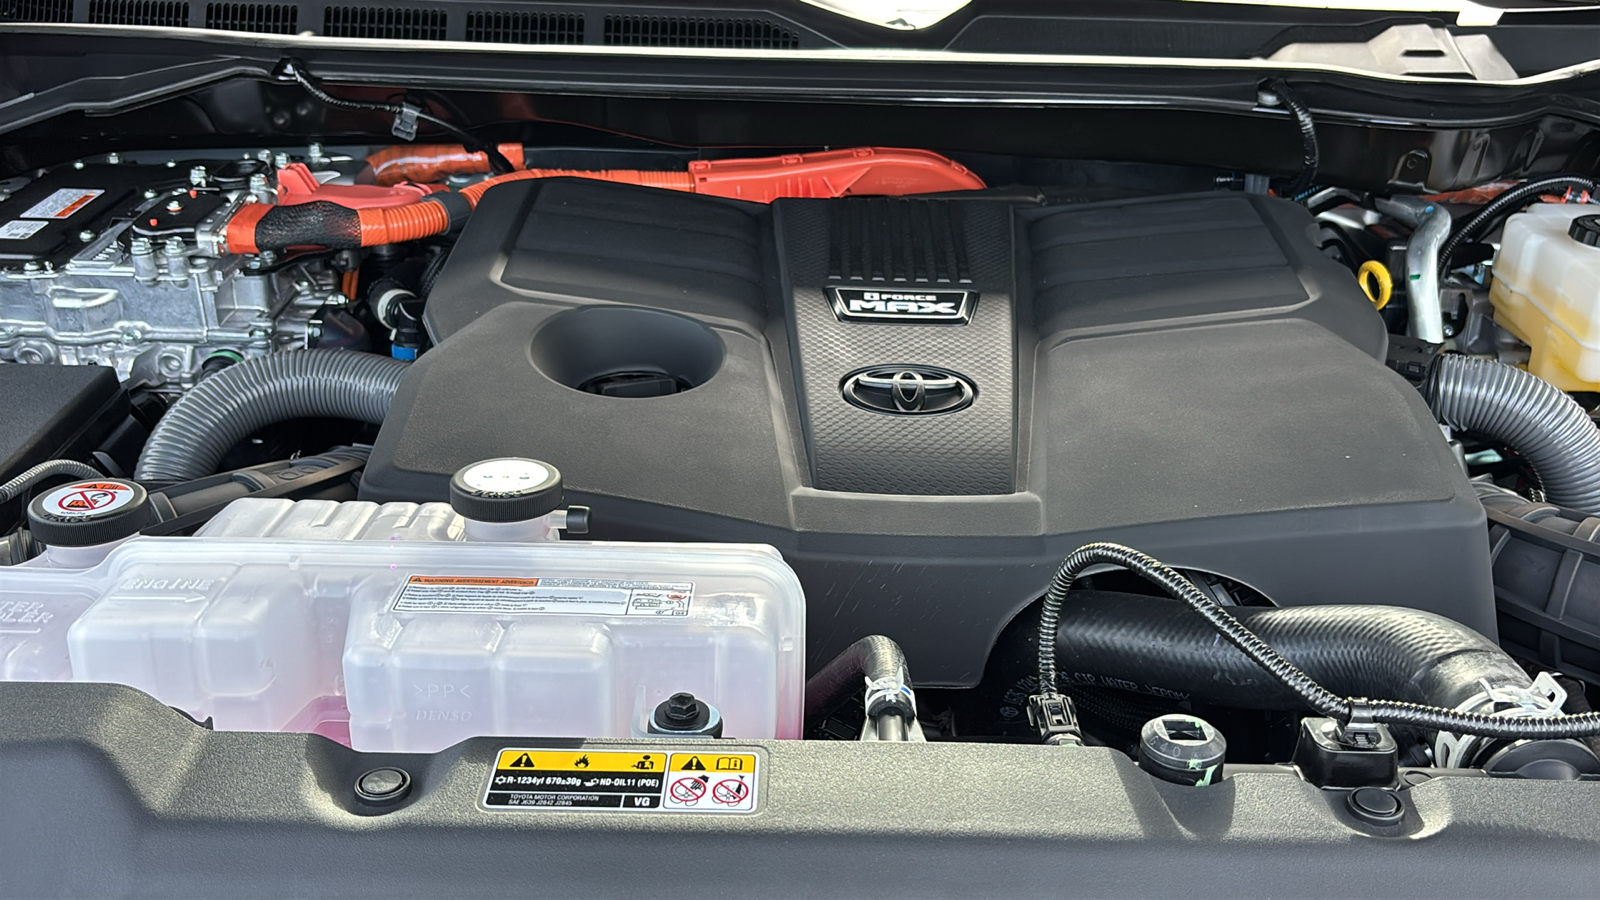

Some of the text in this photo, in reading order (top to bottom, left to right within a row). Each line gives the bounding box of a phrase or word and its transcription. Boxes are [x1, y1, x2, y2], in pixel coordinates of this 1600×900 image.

[849, 299, 957, 313] MAX
[119, 578, 215, 590] ENGINE
[456, 577, 499, 585] AVERTISSEMENT
[415, 709, 473, 722] DENSO
[600, 779, 636, 787] ND-OIL11
[637, 779, 659, 788] (POE)
[633, 797, 651, 807] VG
